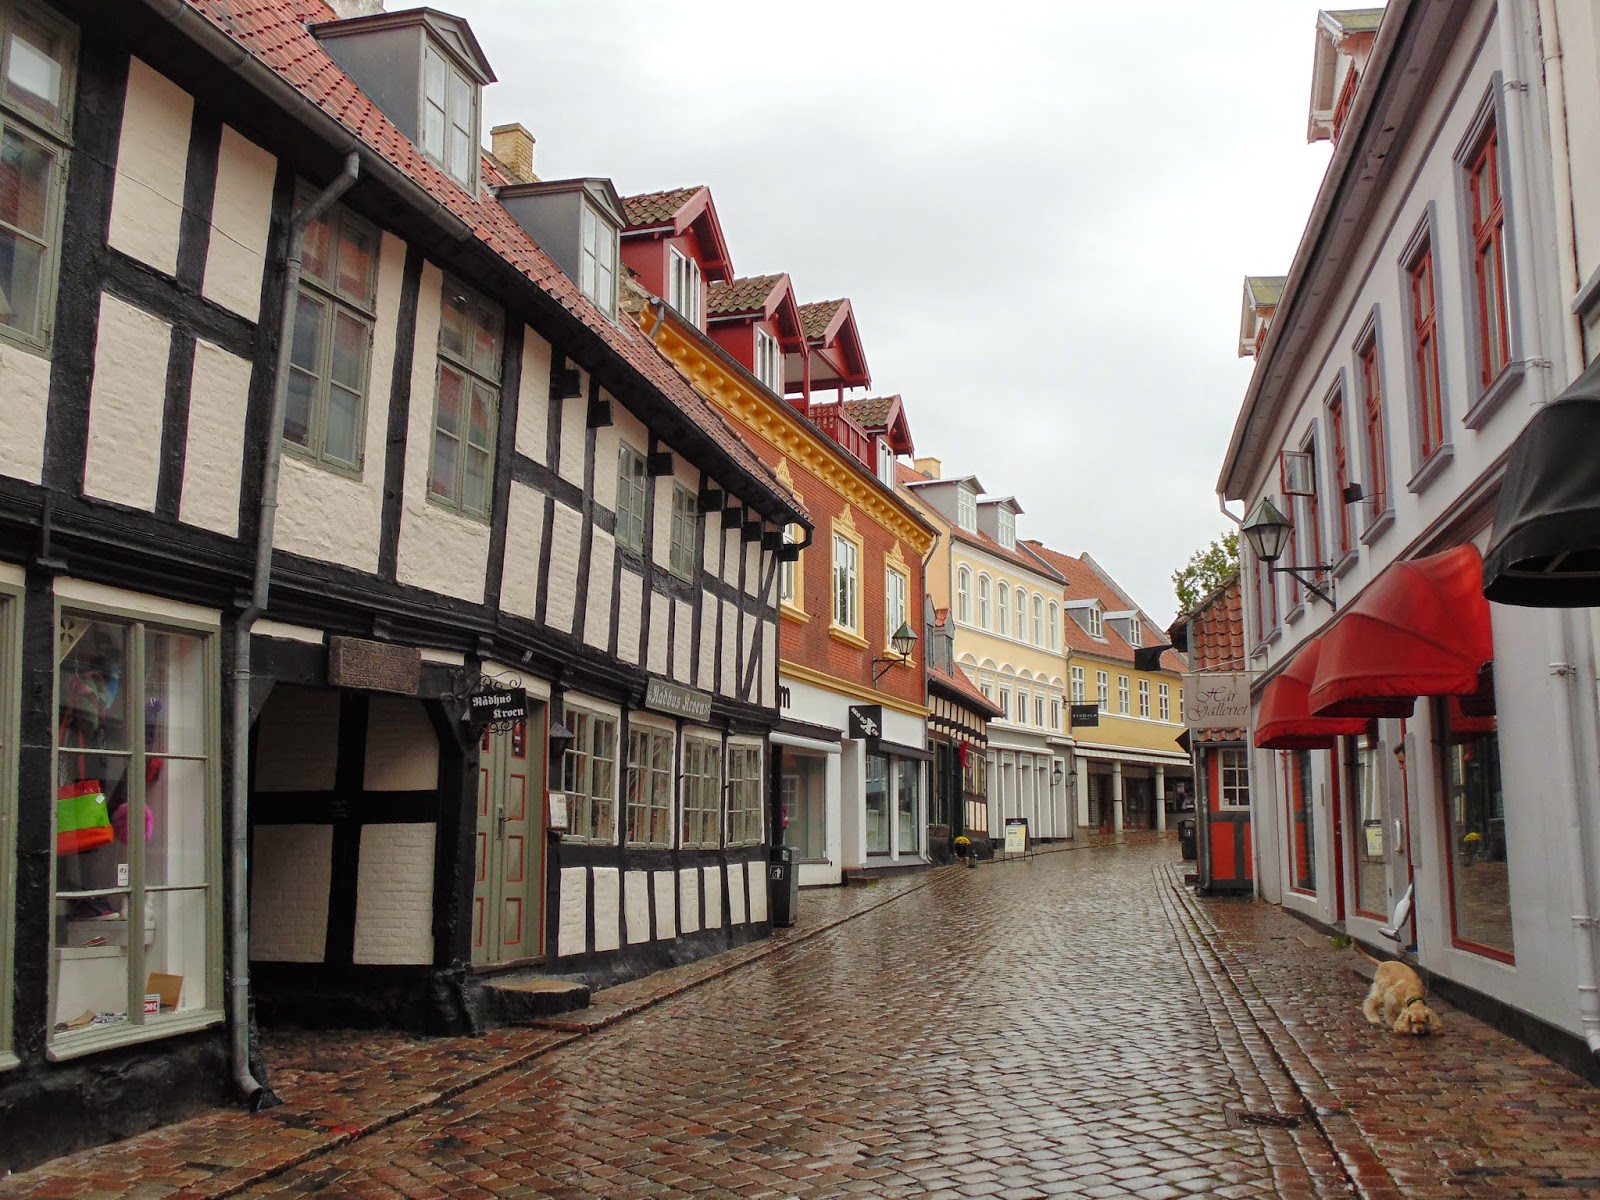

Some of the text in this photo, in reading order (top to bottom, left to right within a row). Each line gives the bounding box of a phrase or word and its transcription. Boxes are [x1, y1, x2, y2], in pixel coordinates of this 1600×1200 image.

[472, 693, 512, 707] Rådhus
[493, 708, 524, 719] Kroen
[1187, 702, 1248, 722] Galleriet
